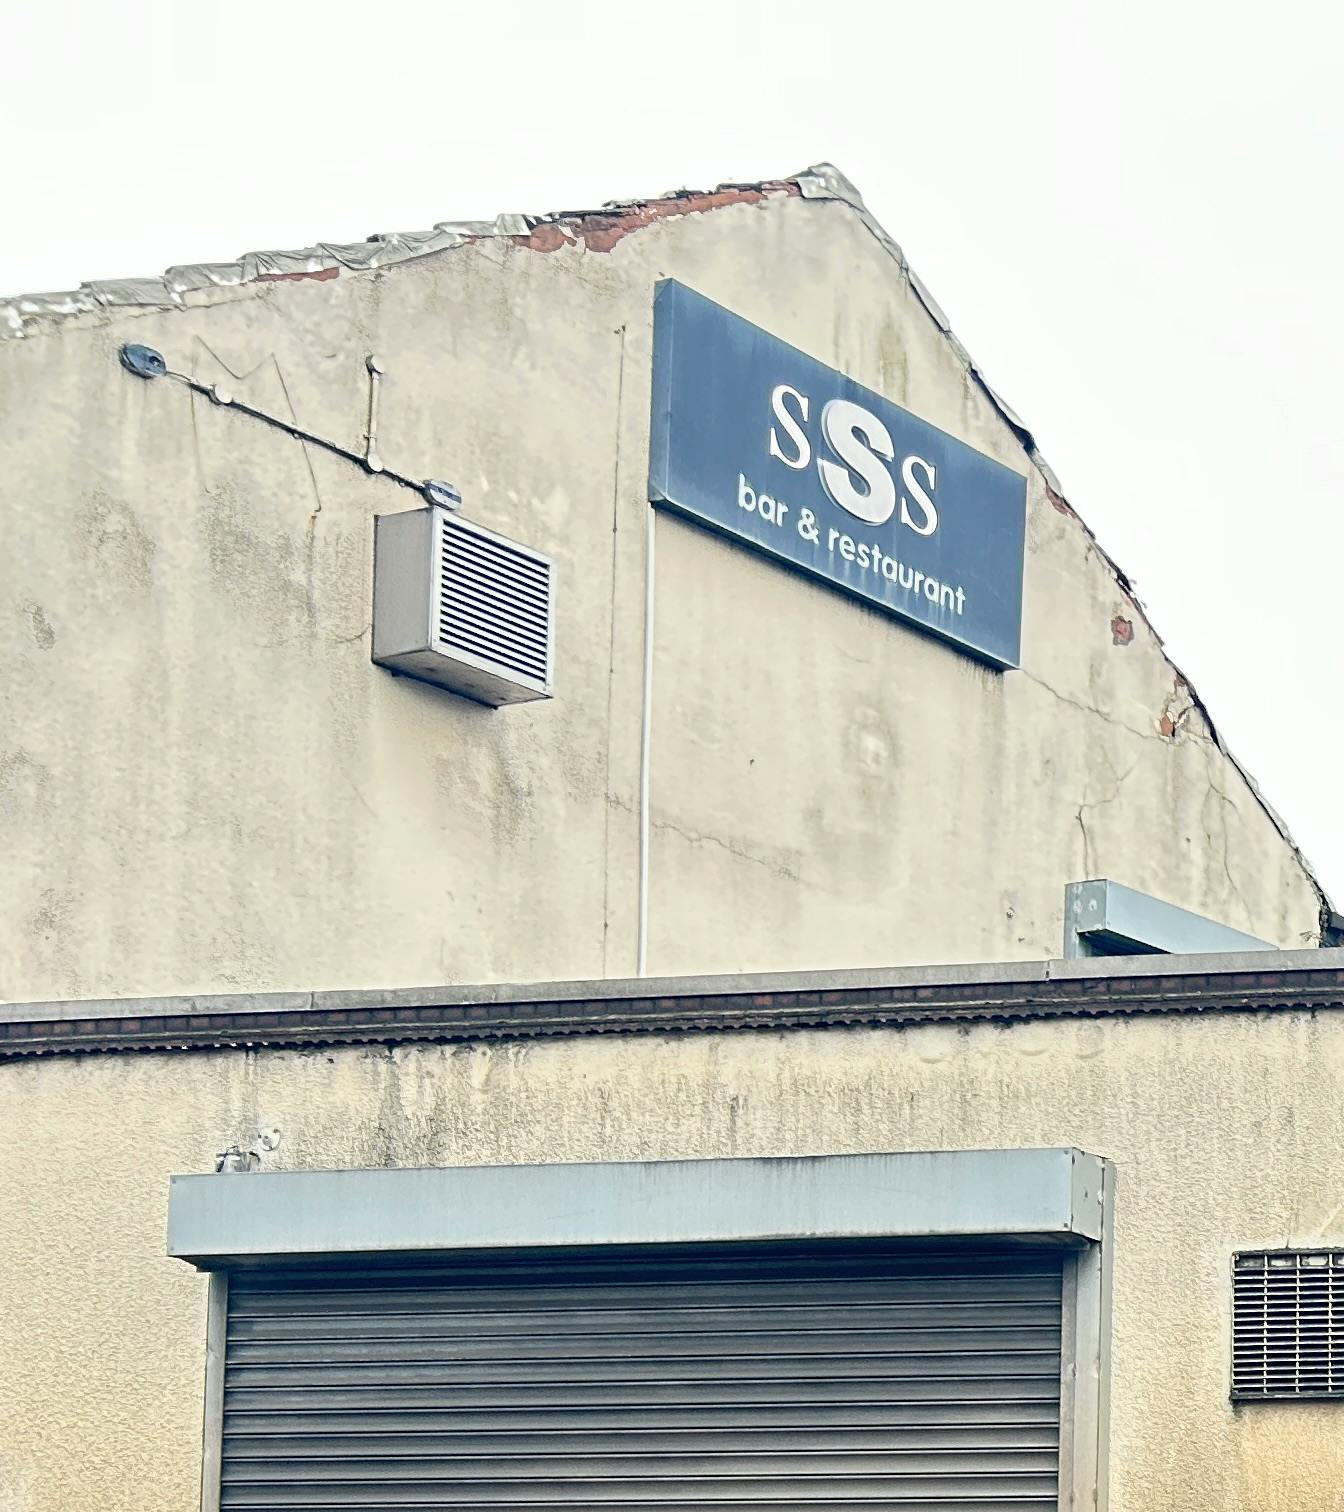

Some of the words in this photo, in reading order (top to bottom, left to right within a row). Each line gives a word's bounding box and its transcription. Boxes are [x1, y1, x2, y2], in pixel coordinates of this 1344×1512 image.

[737, 473, 789, 527] bar
[798, 508, 820, 545] &
[828, 527, 966, 616] restaurant
